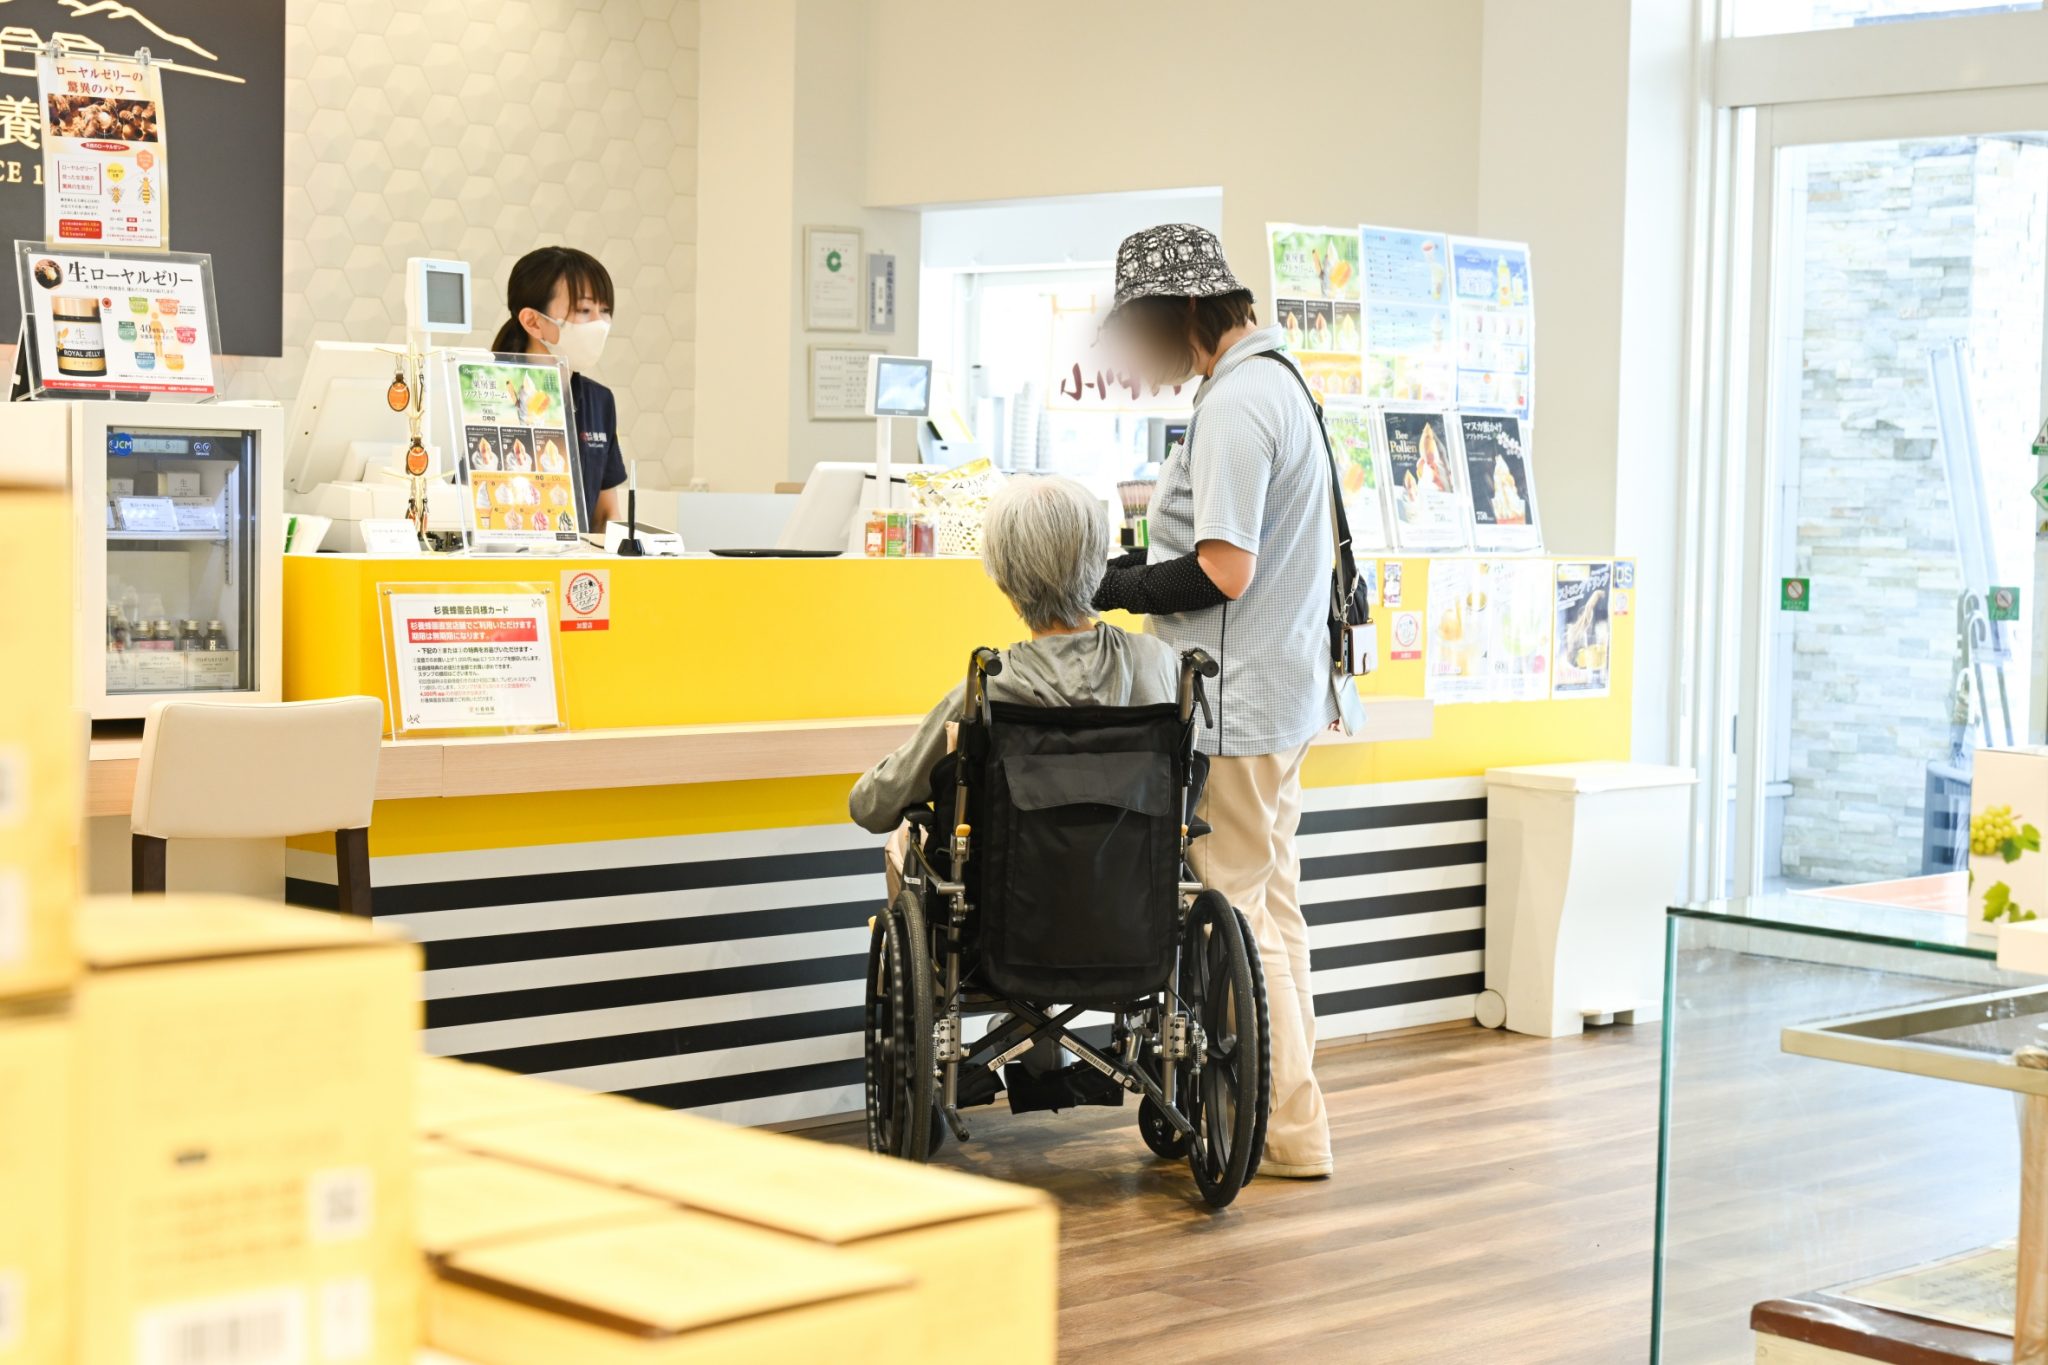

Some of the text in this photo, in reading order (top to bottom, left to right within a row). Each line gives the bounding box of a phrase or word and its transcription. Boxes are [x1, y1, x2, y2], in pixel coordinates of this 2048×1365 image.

[56, 66, 144, 82] ローヤルゼリーの
[67, 80, 136, 94] 驚異のパワー
[68, 261, 194, 288] 生ローヤルゼリー
[63, 349, 84, 357] ROYAL
[464, 390, 508, 400] ソフトクリーム
[1395, 430, 1409, 440] Bee
[1464, 433, 1492, 441] ソフトクリーム
[114, 440, 132, 450] JCM
[1389, 440, 1418, 454] Pollen
[433, 605, 509, 615] 杉養蜂園会員様カード
